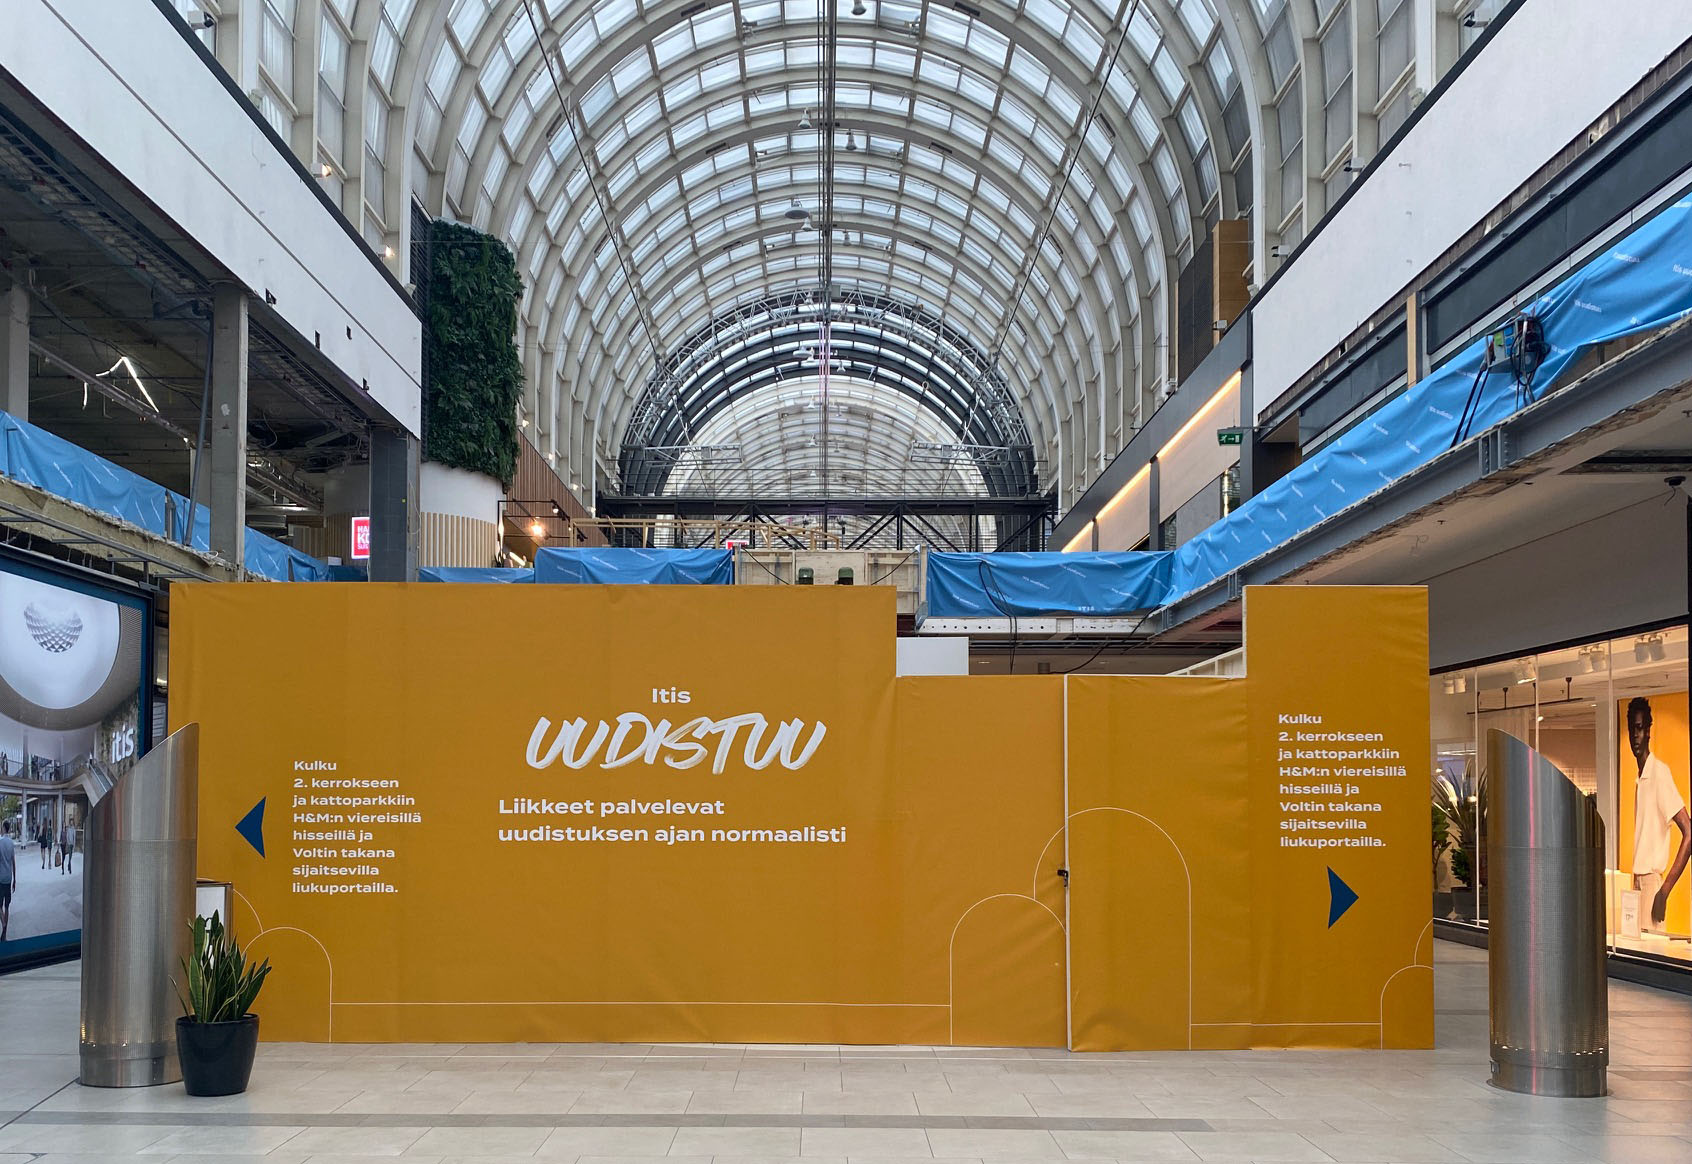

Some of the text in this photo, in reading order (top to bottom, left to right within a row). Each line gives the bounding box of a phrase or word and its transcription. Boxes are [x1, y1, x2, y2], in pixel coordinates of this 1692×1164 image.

[652, 686, 692, 704] Itis
[1278, 713, 1322, 724] Kulku
[112, 722, 134, 764] itis
[525, 711, 827, 775] UUDISTUU
[1278, 731, 1384, 742] 2. kerrokseen
[1277, 748, 1400, 762] ja kattoparkkiin
[294, 760, 337, 771] Kulku
[1279, 765, 1407, 777] H&M:n viereisillä
[293, 777, 399, 789] 2. kerrokseen
[1279, 783, 1360, 797] hisseillä ja
[292, 794, 415, 808] ja kattoparkkiin
[499, 797, 725, 818] Liikkeet palvelevat
[1279, 801, 1382, 812] Voltin takana
[293, 812, 422, 823] H&M:n viereisillä
[1279, 818, 1367, 832] sijaitsevilla
[293, 829, 373, 843] hisseillä ja
[498, 824, 847, 846] uudistuksen ajan normaalisti
[1280, 836, 1386, 849] liukuportailla.
[292, 847, 395, 859] Voltin takana
[292, 864, 380, 878] sijaitsevilla
[292, 881, 399, 896] liukuportailla.
